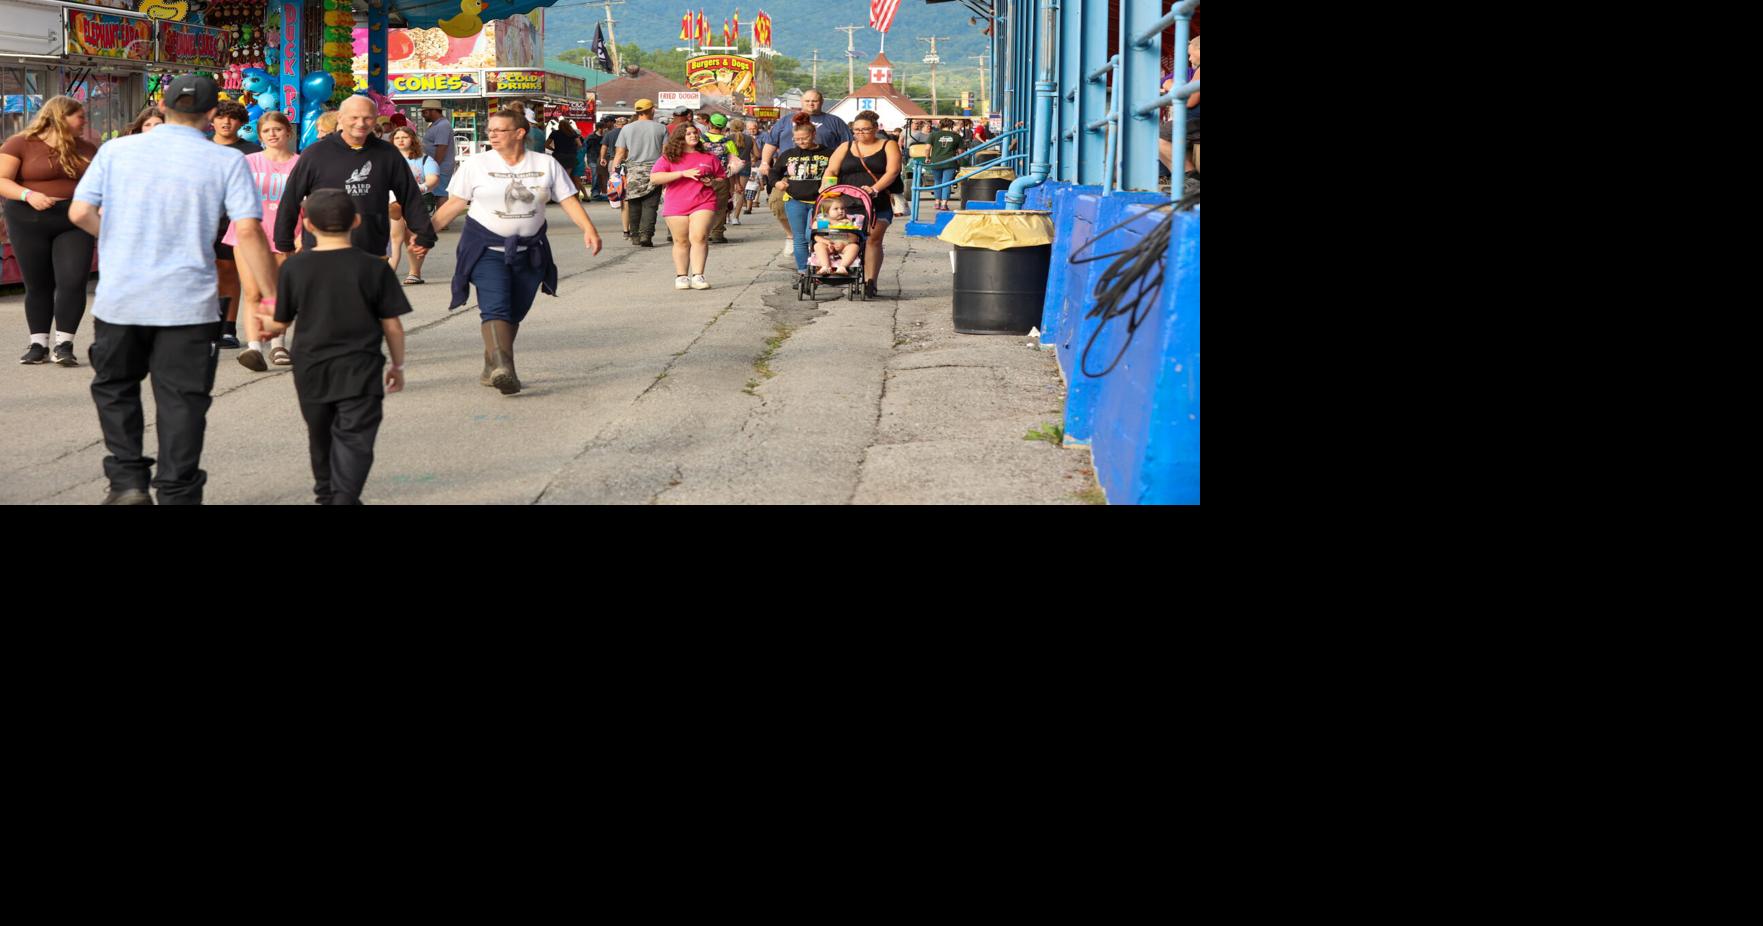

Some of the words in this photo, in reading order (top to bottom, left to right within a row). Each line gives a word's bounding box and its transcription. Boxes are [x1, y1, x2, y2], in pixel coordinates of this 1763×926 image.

[83, 19, 119, 49] ELEPHANT
[285, 3, 297, 76] DUCK
[691, 59, 720, 69] Burgers
[731, 60, 749, 70] Dogs
[393, 75, 462, 91] CONES
[507, 75, 537, 83] COLD
[497, 82, 542, 91] DRINKS
[660, 92, 677, 100] FRIED
[679, 92, 699, 100] DOUGH
